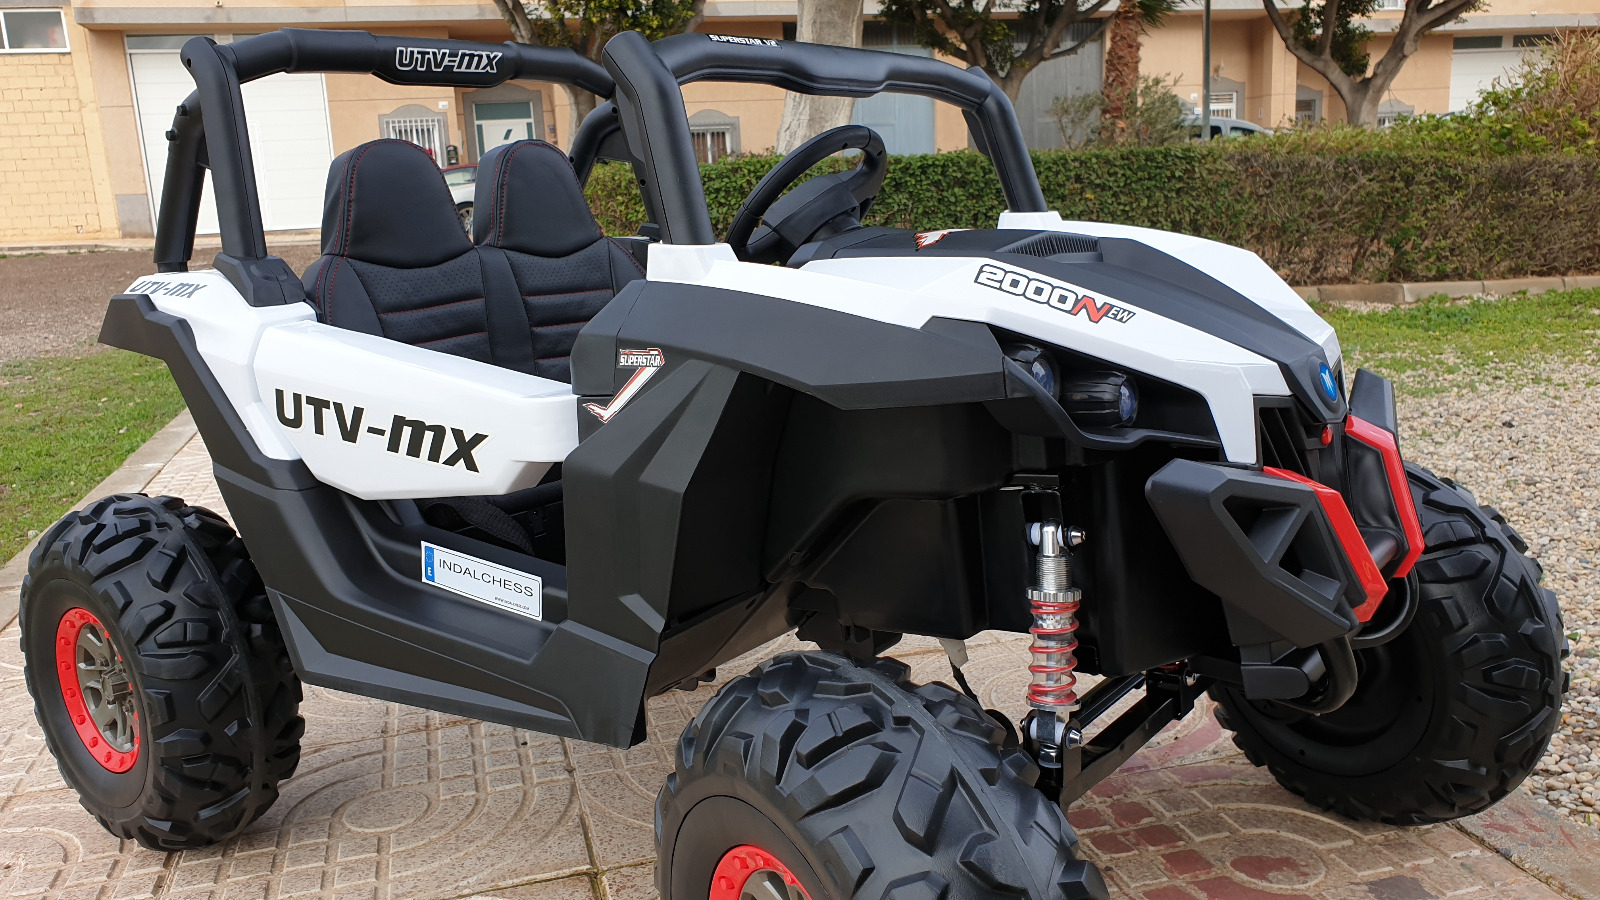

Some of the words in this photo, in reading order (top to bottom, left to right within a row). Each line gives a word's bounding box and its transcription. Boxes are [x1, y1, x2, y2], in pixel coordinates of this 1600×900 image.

[708, 34, 762, 46] SUPERSTAR
[619, 355, 662, 367] SUPERSTAR
[439, 558, 533, 597] INDALCHESS
